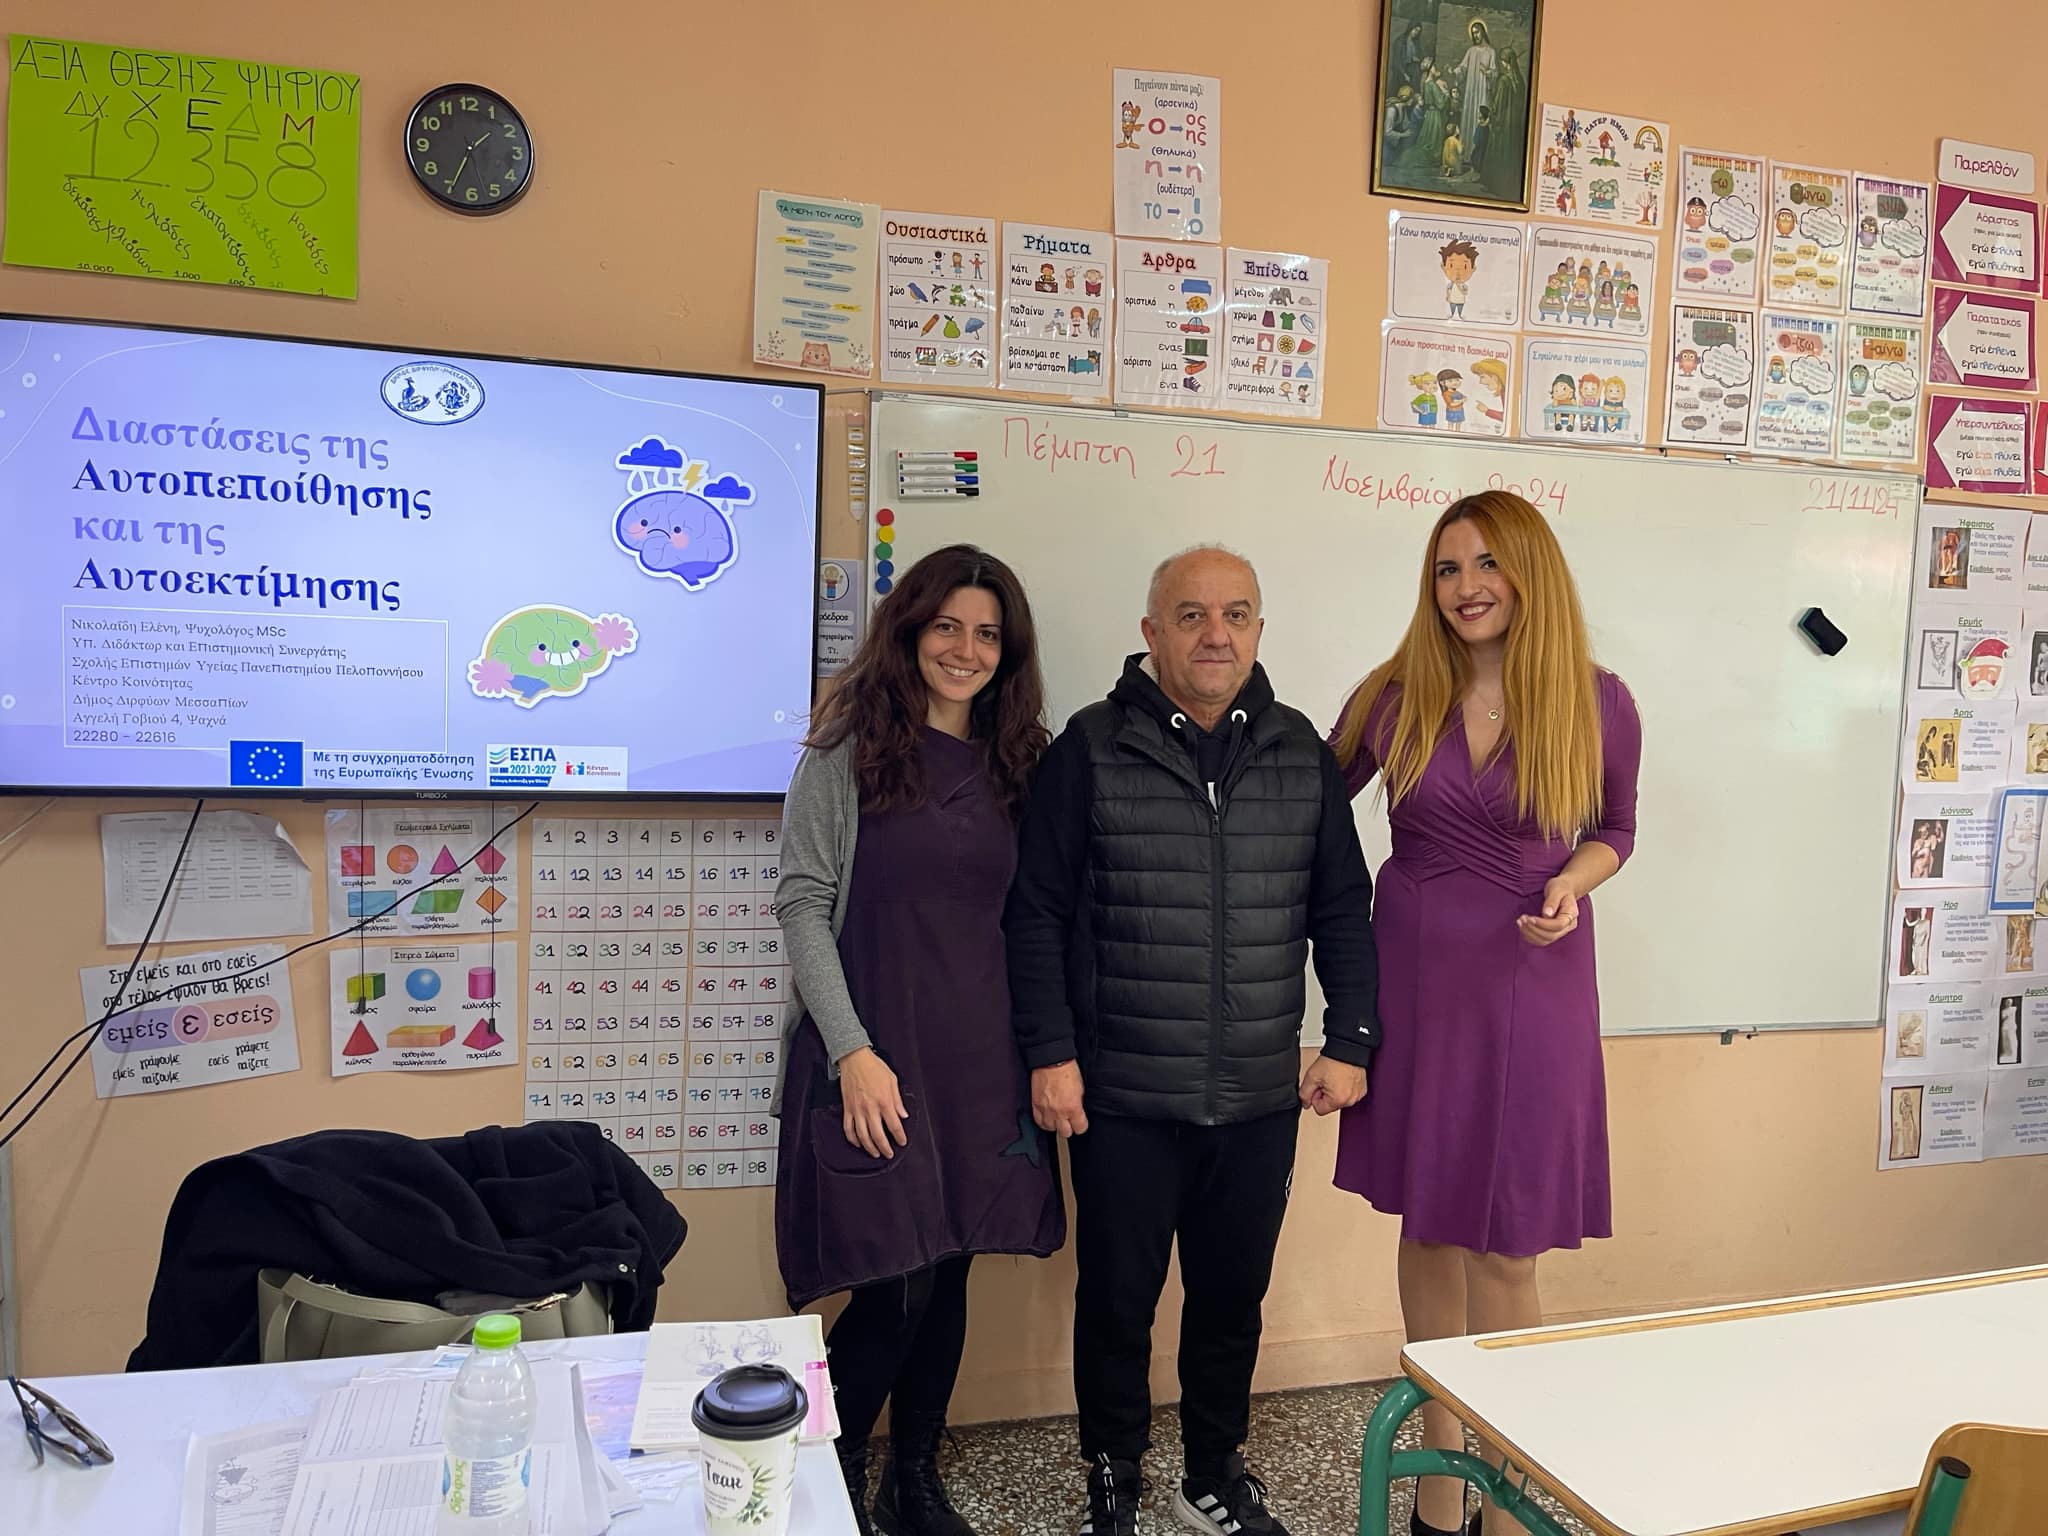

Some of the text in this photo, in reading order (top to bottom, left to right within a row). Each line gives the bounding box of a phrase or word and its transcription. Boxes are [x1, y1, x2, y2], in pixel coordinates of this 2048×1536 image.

[14, 39, 360, 114] ΑΞΙΑ ΘΕΣΗΣ ΨΗΦΙΟΥ
[439, 101, 452, 115] 11
[460, 97, 479, 111] 12
[1155, 97, 1198, 110] (αρσενικά)
[488, 105, 495, 119] 1
[187, 98, 222, 131] Ε
[226, 102, 260, 134] Δ
[282, 112, 314, 146] Μ
[422, 116, 440, 130] 10
[1186, 114, 1207, 130] ος
[504, 124, 516, 138] 2
[1186, 129, 1207, 146] ης
[416, 138, 429, 151] 9
[512, 146, 523, 160] 3
[1152, 147, 1196, 159] (θηλυκά)
[424, 162, 437, 175] 8
[1955, 155, 2019, 178] Παρελθόν
[505, 169, 517, 182] 4
[444, 180, 453, 194] 7
[489, 184, 500, 197] 5
[1157, 182, 1195, 197] (ουδέτερα)
[466, 188, 478, 201] 6
[1976, 213, 2019, 227] Αόριστος
[887, 221, 988, 244] Ουσιαστικά
[1023, 234, 1091, 255] Ρήματα
[1971, 244, 1989, 254] εγώ
[889, 253, 923, 265] πρόσωπο
[1142, 252, 1197, 272] Άρθρα
[1969, 259, 1986, 270] εγώ
[1011, 264, 1028, 273] κάτι
[1244, 261, 1309, 281] Επίθετα
[1011, 276, 1032, 286] κάνω
[1125, 296, 1157, 307] οριστικό
[1011, 303, 1045, 316] παθαίνω
[1233, 312, 1257, 321] χρώμα
[889, 318, 919, 329] πράγμα
[1967, 311, 2022, 327] Παρατατικός
[1232, 335, 1255, 345] σχήμα
[890, 349, 911, 360] τόπος
[1123, 357, 1152, 368] αόριστο
[1229, 384, 1275, 394] συμπεριφορά
[72, 406, 389, 470] Διαστάσεις της
[1004, 417, 1137, 479] Πέμπτη
[1171, 434, 1225, 477] 21
[72, 459, 432, 520] Αυτοπεποίθησης
[72, 515, 225, 556] και της
[73, 557, 400, 611] Αυτοεκτίμησης
[140, 621, 181, 635] Ελένη,
[186, 623, 254, 637] Ψυχολόγος
[257, 626, 286, 637] MSc
[1958, 617, 1983, 627] Ερμής
[72, 638, 346, 659] Υπ. Διδάκτωρ και Επιστημονική Συνεργάτης
[72, 657, 423, 679] Σχολής Επιστημών Υγείας Πανεπιστημίου Πελοποννήσου
[73, 675, 193, 691] Κέντρο Κοινότητας
[73, 694, 248, 708] Δήμος Διρφύων Μεσσαπίων
[73, 713, 119, 725] Αγγελή
[124, 713, 167, 724] Γοβιού
[187, 714, 227, 728] Ψαχνά
[73, 730, 176, 743] 22280 22616
[313, 752, 474, 766] Με τη συγχρηματοδότηση
[510, 748, 556, 761] ΕΣΠΑ
[314, 767, 473, 781] της Ευρωπαϊκής Ένωσης
[510, 765, 556, 774] 2021-2027
[1940, 806, 1974, 816] Διόνυσος
[544, 830, 775, 844] 1 2 3 4 5 6 7 8
[137, 953, 257, 983] εμείς και στο εσείς
[234, 972, 270, 993] βρεις!
[535, 978, 776, 994] 41 42 43 44 45 46 47 48
[1929, 993, 1963, 1002] Δήμητρα
[108, 1004, 274, 1043] εμείς ε εσείς
